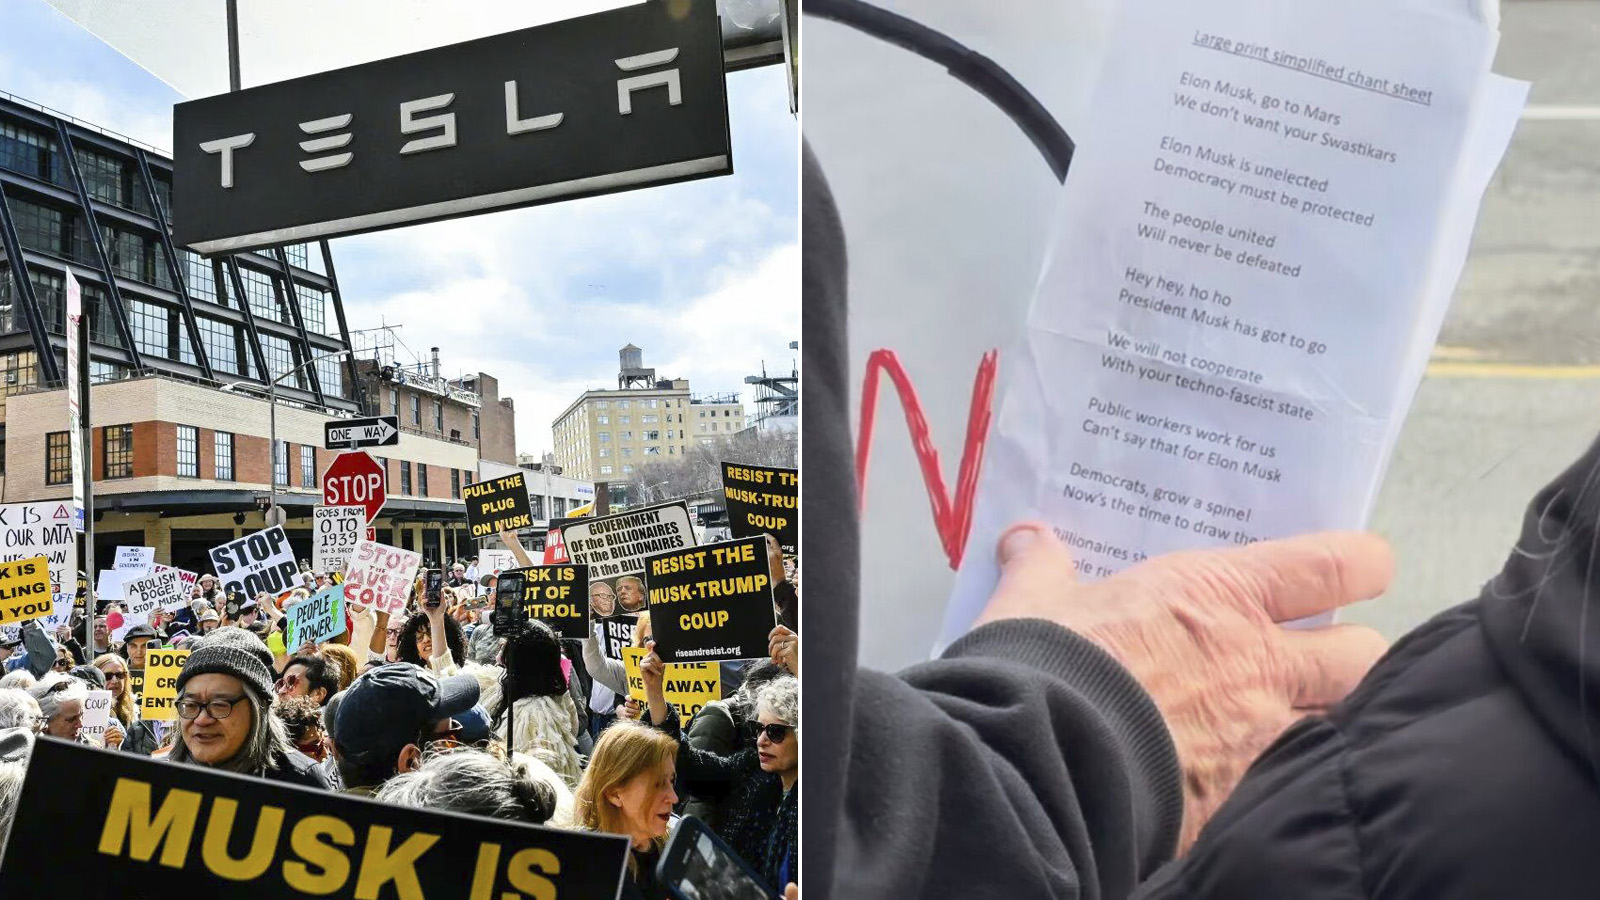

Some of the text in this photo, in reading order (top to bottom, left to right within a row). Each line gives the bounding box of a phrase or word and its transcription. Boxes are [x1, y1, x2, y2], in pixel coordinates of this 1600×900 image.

[1194, 30, 1434, 103] Large print simplified chant sheet
[1180, 71, 1341, 126] Elon Musk, go to Mars
[199, 47, 682, 188] TESLA
[1174, 93, 1198, 110] We
[1243, 114, 1280, 133] want
[1284, 124, 1317, 144] your
[1321, 132, 1397, 164] Swastikars
[1160, 136, 1329, 193] Elon Musk is unelected
[1154, 157, 1375, 227] Democracy must be protected
[1143, 201, 1277, 248] The people united
[1137, 223, 1302, 278] Will never be defeated
[1125, 267, 1232, 307] Hey hey, ho ho
[1118, 288, 1328, 355] President Musk has got to go
[1106, 331, 1264, 384] We will not cooperate
[1101, 354, 1315, 422] With your techno-fascist state
[331, 426, 387, 440] ONE WAY
[1088, 397, 1277, 459] Public workers work for us
[1123, 432, 1147, 450] say
[1149, 437, 1180, 456] that
[1182, 444, 1205, 462] for
[1207, 451, 1239, 471] Elon
[1242, 461, 1283, 483] Musk
[327, 473, 381, 504] STOP
[463, 475, 522, 499] PULL THE
[727, 466, 774, 484] RESIST
[1069, 462, 1150, 497] Democrats,
[1152, 487, 1191, 506] grow
[1193, 498, 1202, 509] a
[23, 507, 41, 524] IS
[315, 508, 365, 518] GOES FROM
[481, 497, 515, 515] PLUG
[1063, 484, 1107, 508] Now's
[1111, 495, 1136, 515] the
[1138, 503, 1171, 525] time
[1174, 514, 1190, 530] to
[1193, 520, 1231, 541] draw
[6, 523, 74, 547] OUR DATA
[336, 518, 358, 532] TO
[472, 513, 531, 536] ON MUSK
[588, 510, 660, 535] GOVERNMENT
[747, 513, 787, 530] COUP
[212, 527, 285, 575] STOP
[321, 531, 358, 547] 1939
[570, 539, 584, 553] OF
[585, 537, 604, 550] the
[605, 521, 679, 548] BILLIONAIRES
[574, 552, 588, 564] BY
[590, 550, 609, 563] the
[610, 535, 684, 559] BILLIONAIRES
[17, 563, 36, 576] IS
[248, 562, 264, 572] THE
[358, 543, 418, 573] STOP
[369, 564, 386, 574] THE
[600, 562, 620, 576] the
[652, 544, 756, 576] RESIST THE
[129, 572, 176, 596] ABOLISH
[223, 561, 298, 608] COUP
[346, 566, 411, 600] MUSK
[557, 567, 575, 581] IS
[133, 593, 184, 614] STOP MUSK
[141, 583, 175, 602] DOGE!
[344, 583, 404, 614] COUP
[546, 585, 571, 600] OF
[649, 574, 768, 605] MUSK-TRUMP
[10, 601, 50, 618] YOU
[296, 594, 330, 627] PEOPLE
[679, 610, 729, 631] COUP
[298, 616, 332, 646] POWER
[675, 645, 741, 658] riseandresist.org
[666, 680, 716, 693] AWAY
[85, 699, 109, 710] COUP
[98, 777, 561, 900] MUSK IS
